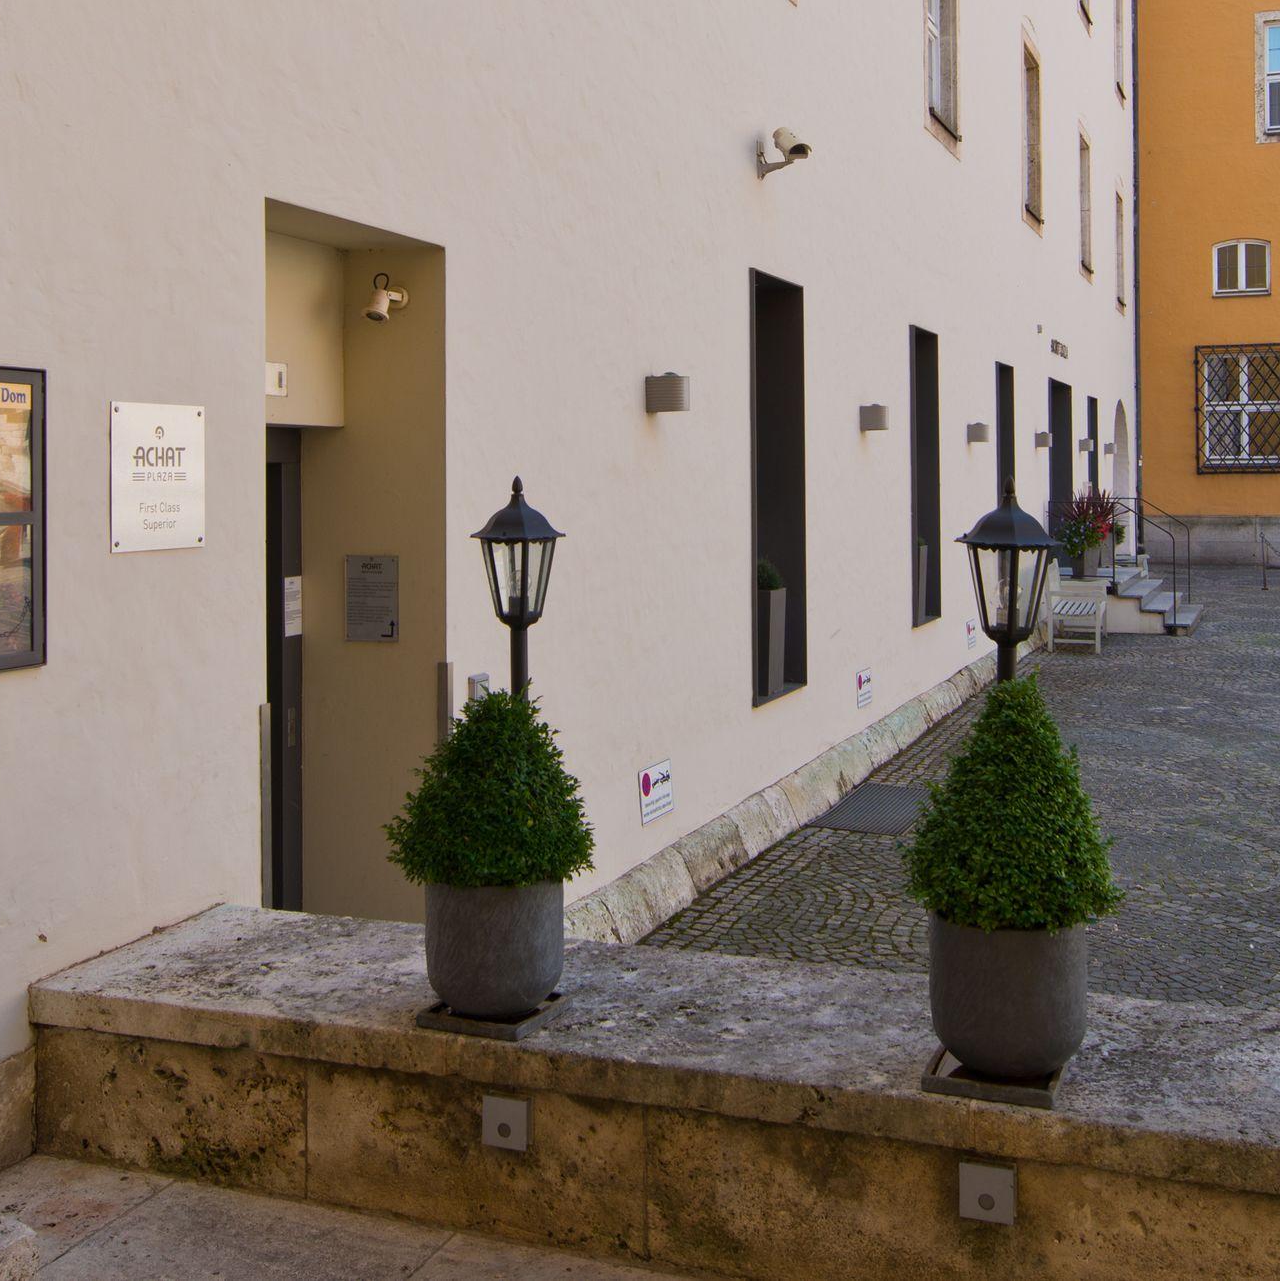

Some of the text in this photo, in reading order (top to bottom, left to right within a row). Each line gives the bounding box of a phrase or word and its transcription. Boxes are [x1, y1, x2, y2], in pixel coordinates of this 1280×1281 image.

[0, 387, 27, 404] Dom
[132, 446, 186, 467] ACHAT
[147, 472, 173, 482] PLAZA
[139, 502, 181, 514] First Class
[143, 519, 177, 532] Superior
